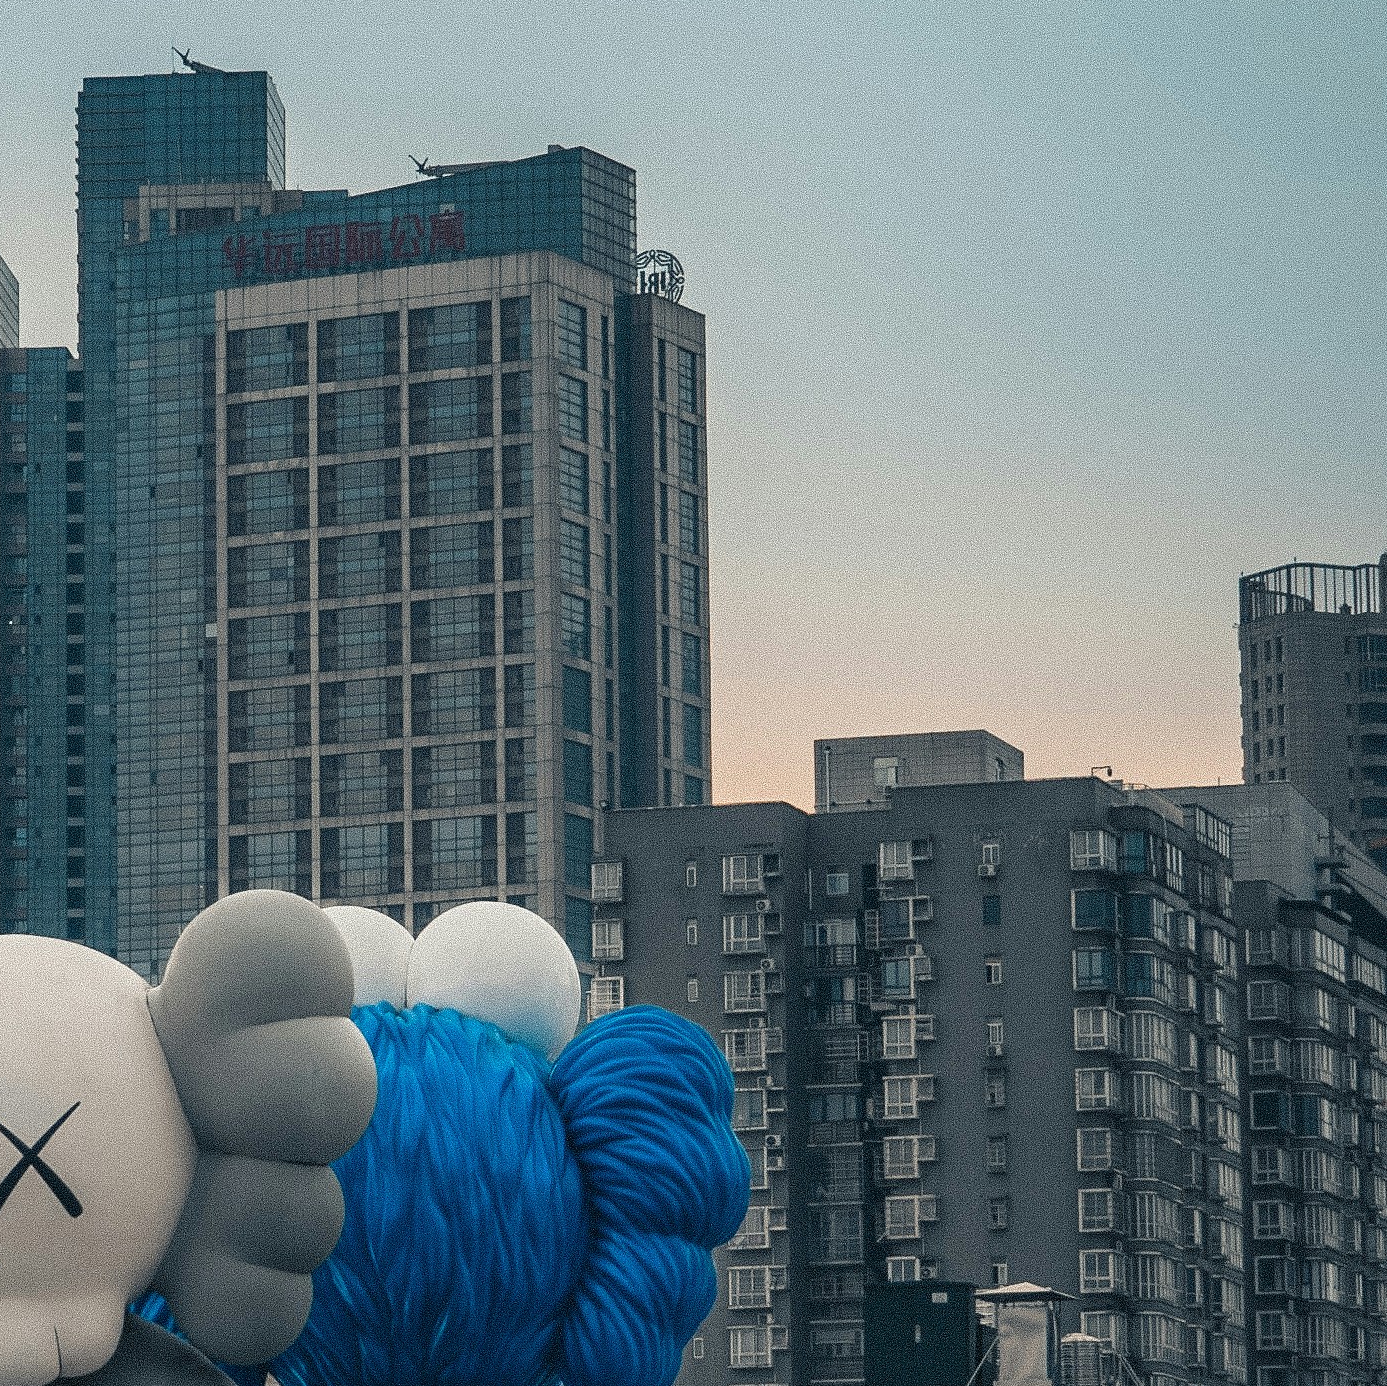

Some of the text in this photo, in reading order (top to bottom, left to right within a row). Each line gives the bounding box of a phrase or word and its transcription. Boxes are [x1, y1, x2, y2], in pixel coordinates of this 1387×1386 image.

[222, 210, 467, 277] 华远国际公寓
